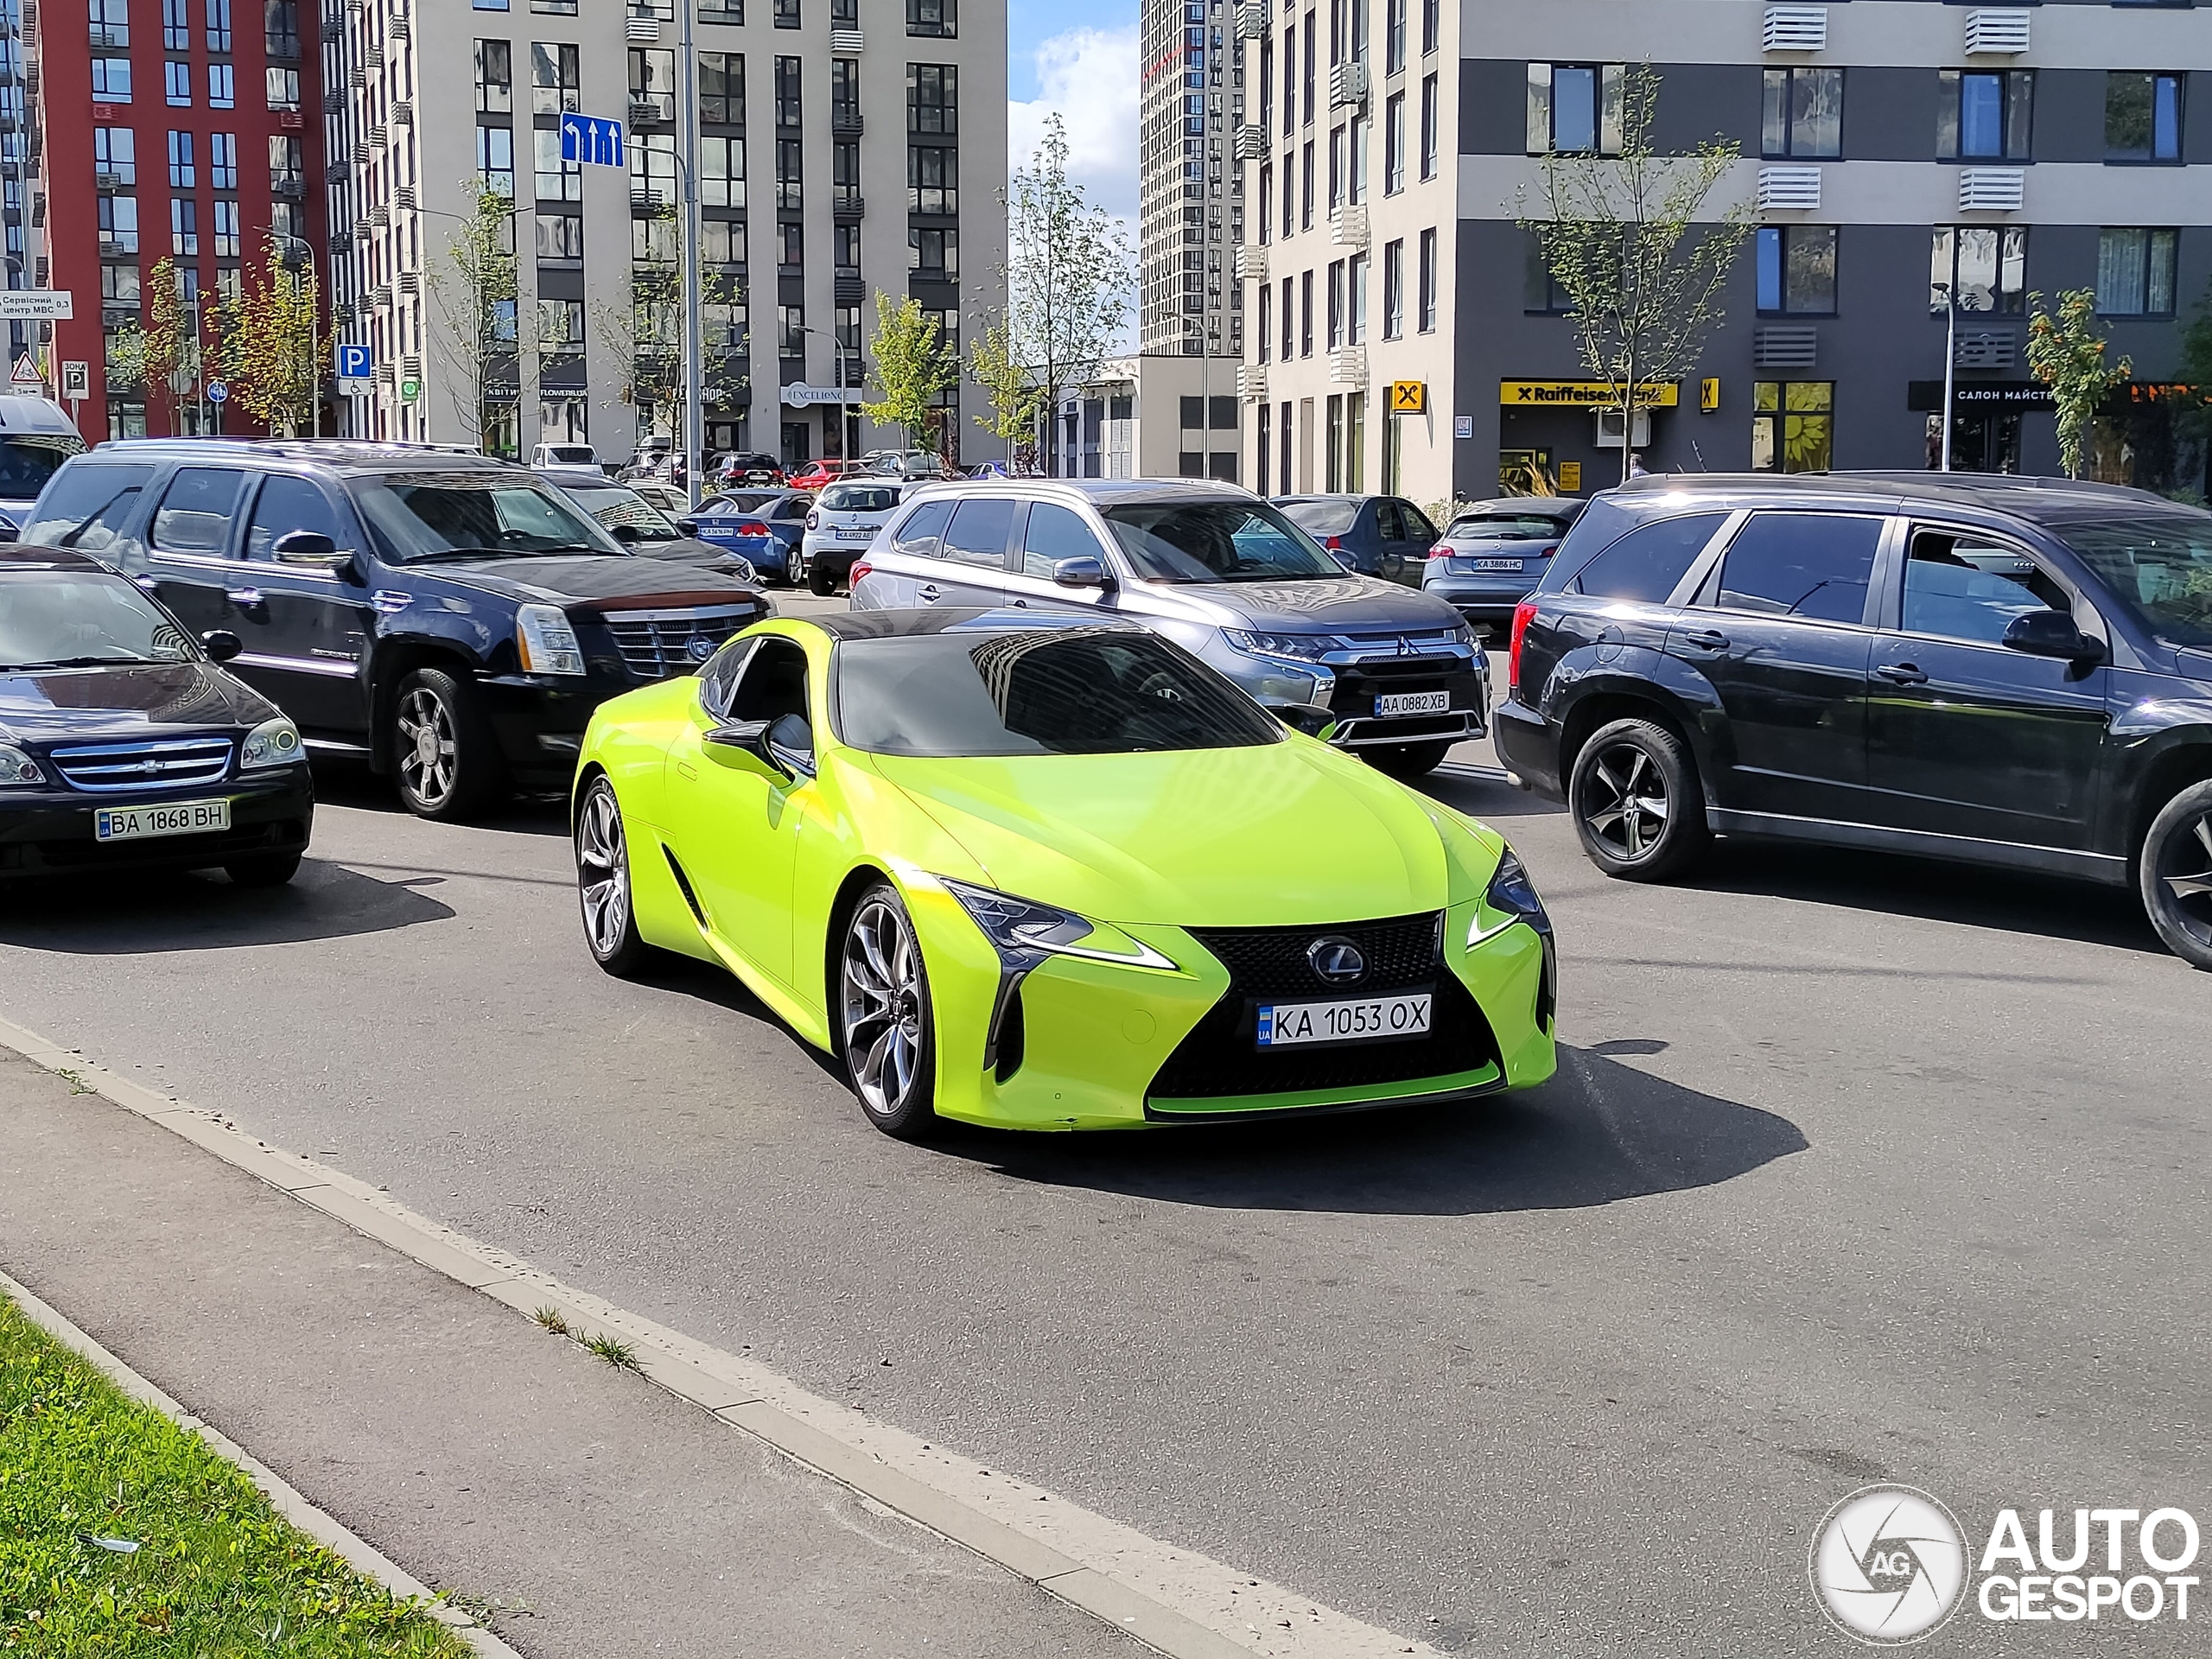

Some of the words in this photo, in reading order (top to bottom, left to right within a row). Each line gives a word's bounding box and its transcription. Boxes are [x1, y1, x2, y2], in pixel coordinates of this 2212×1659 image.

[3, 296, 52, 305] Сервісний
[56, 301, 69, 309] 0,3
[347, 348, 364, 374] P
[71, 372, 81, 388] P
[1534, 386, 1614, 402] Raiffeisen
[1958, 391, 2000, 400] САЛОН
[1382, 697, 1399, 713] AA
[1402, 696, 1427, 711] 0882
[1430, 694, 1446, 709] XB
[111, 813, 140, 834] BA
[146, 810, 189, 830] 1868
[194, 805, 221, 826] BH
[1275, 1010, 1314, 1039] KA
[1324, 1003, 1382, 1035] 1053
[1389, 1000, 1428, 1030] OX
[1258, 1031, 1271, 1040] UA
